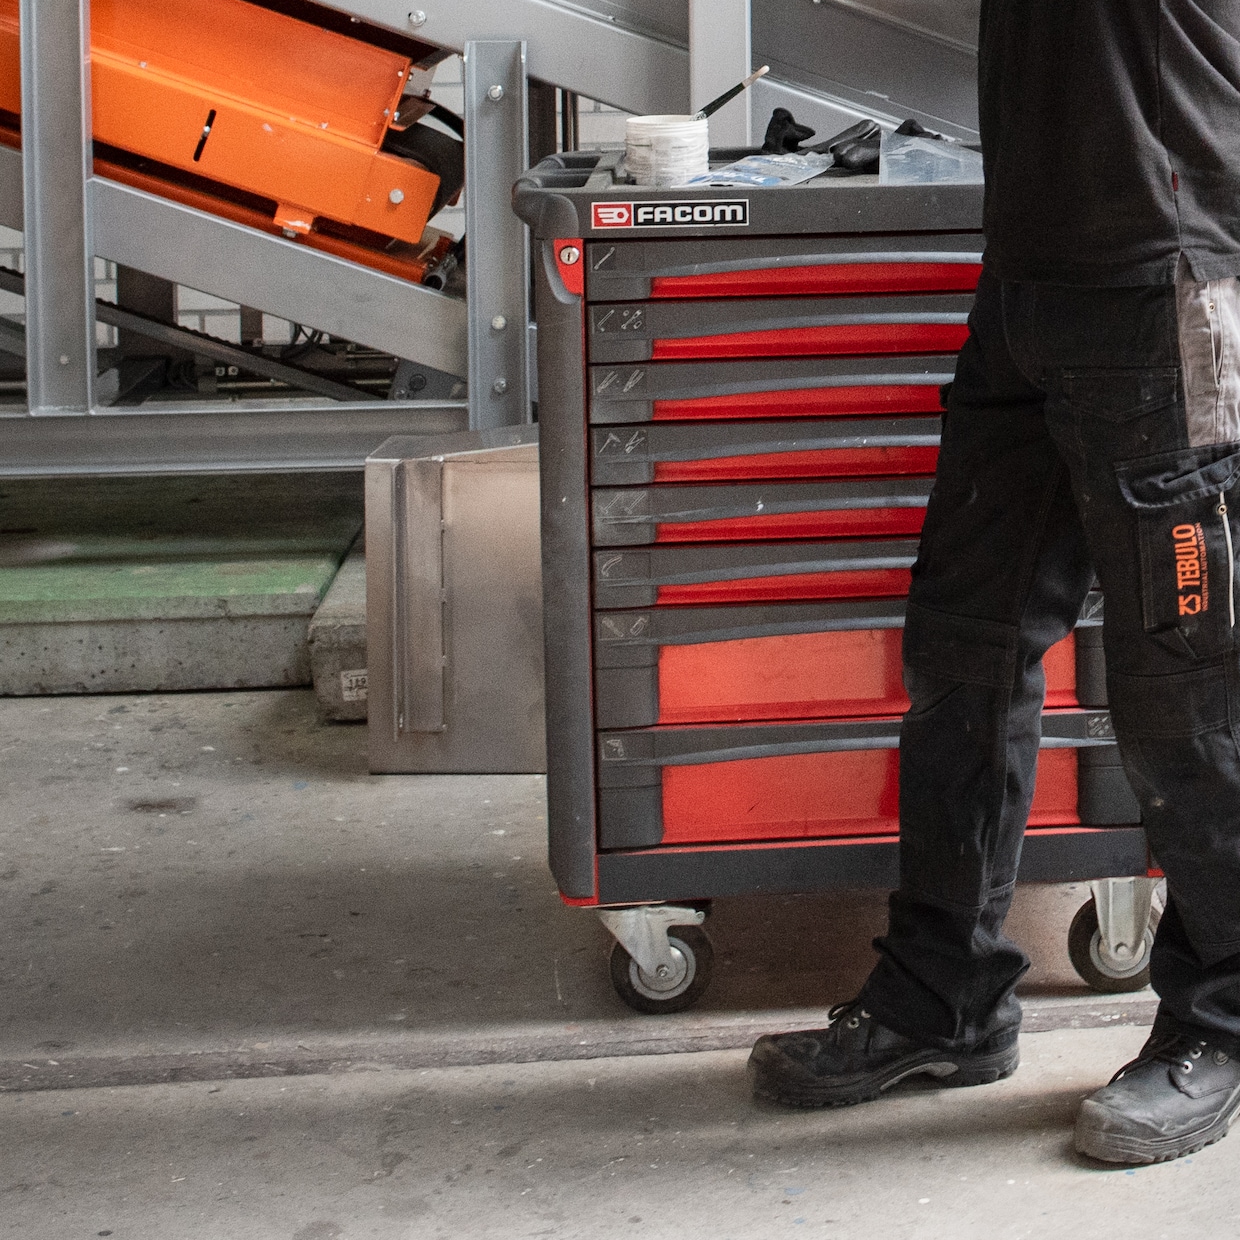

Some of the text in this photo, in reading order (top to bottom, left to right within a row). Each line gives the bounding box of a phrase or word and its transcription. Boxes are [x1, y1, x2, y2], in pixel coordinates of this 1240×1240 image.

[637, 204, 744, 223] FACOM
[1172, 523, 1201, 590] TEBULO
[1195, 522, 1208, 571] AUTOMATION
